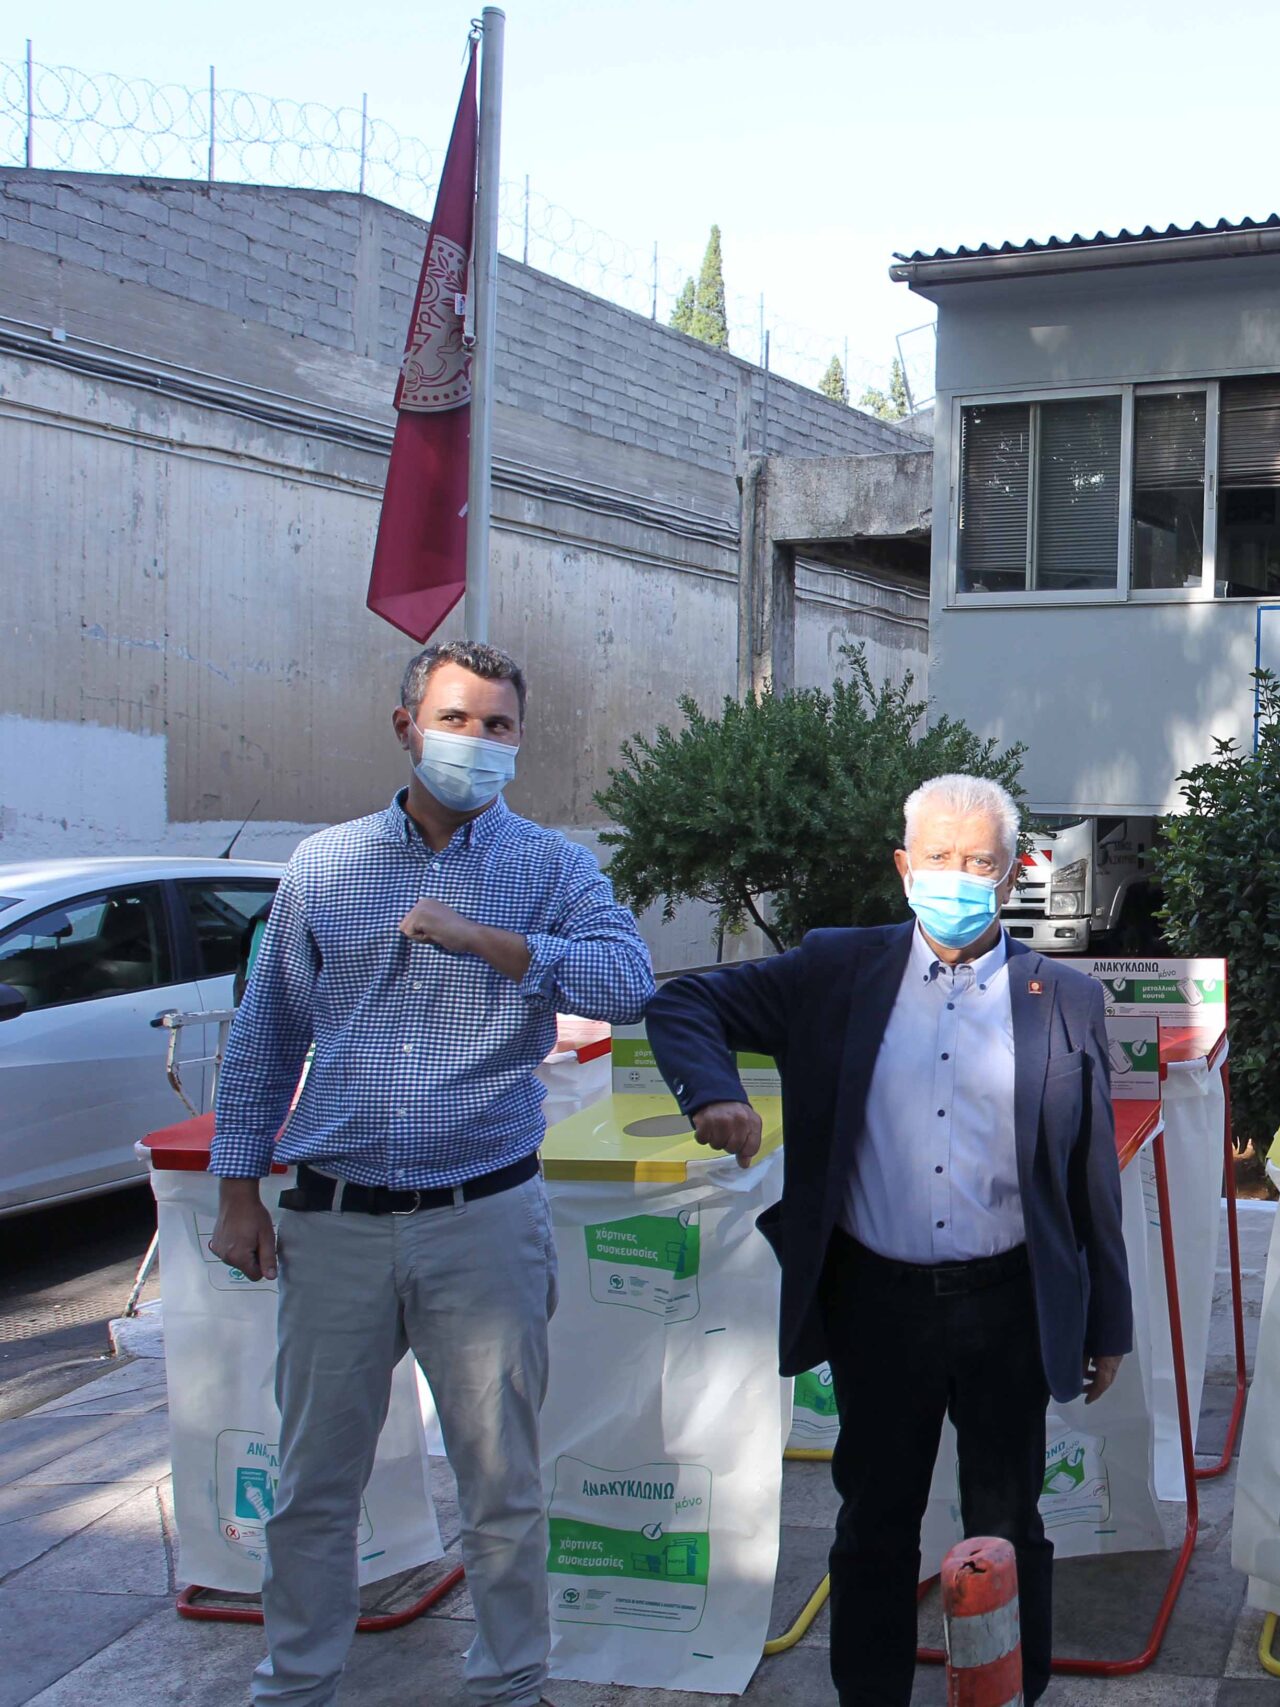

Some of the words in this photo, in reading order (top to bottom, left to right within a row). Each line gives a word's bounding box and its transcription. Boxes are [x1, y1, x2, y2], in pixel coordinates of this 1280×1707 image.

[1093, 962, 1159, 973] ΑΝΑΚΥΚΛΩΝΩ
[596, 1229, 638, 1245] χάρτινες
[596, 1244, 659, 1262] συσκευασίες
[582, 1479, 675, 1500] ΑΝΑΚΥΚΛΩΝΩ
[674, 1496, 703, 1514] μόνο
[559, 1538, 604, 1552] χάρτινες
[558, 1555, 624, 1569] συσκευασίες
